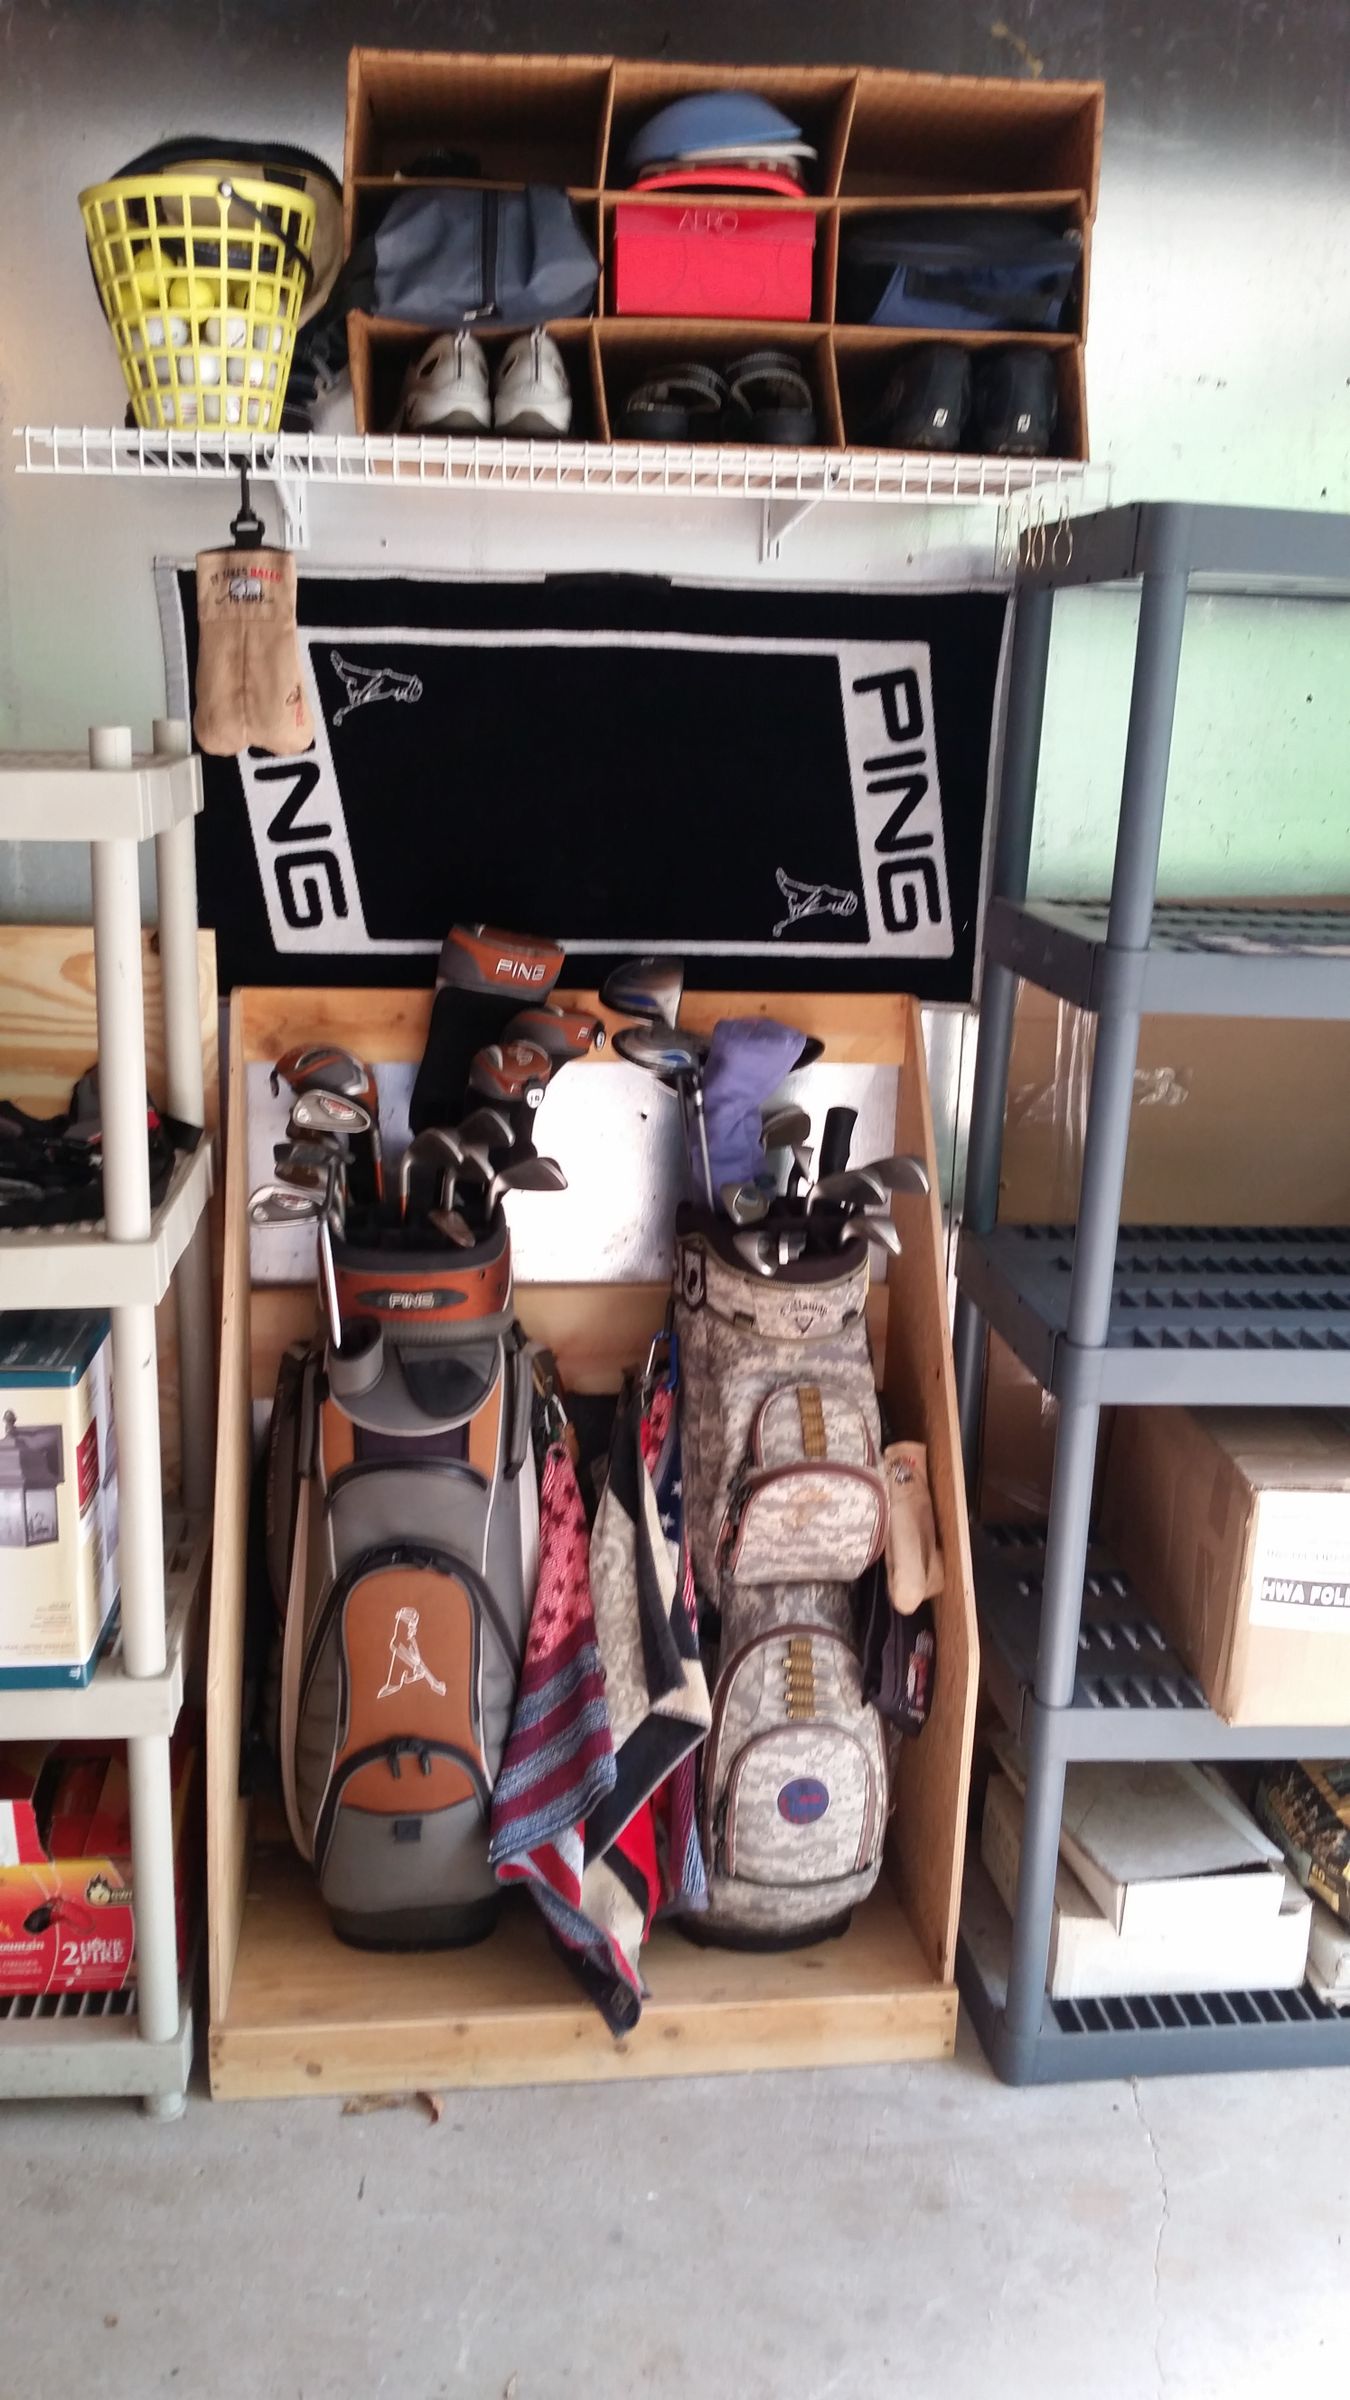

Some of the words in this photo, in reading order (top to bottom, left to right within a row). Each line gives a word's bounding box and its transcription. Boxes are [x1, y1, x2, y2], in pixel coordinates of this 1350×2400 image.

[852, 667, 942, 933] PING
[247, 738, 348, 929] NG
[496, 958, 546, 981] PING
[389, 1292, 435, 1309] PING
[1262, 1580, 1305, 1603] HWA
[61, 1941, 80, 1966] 2
